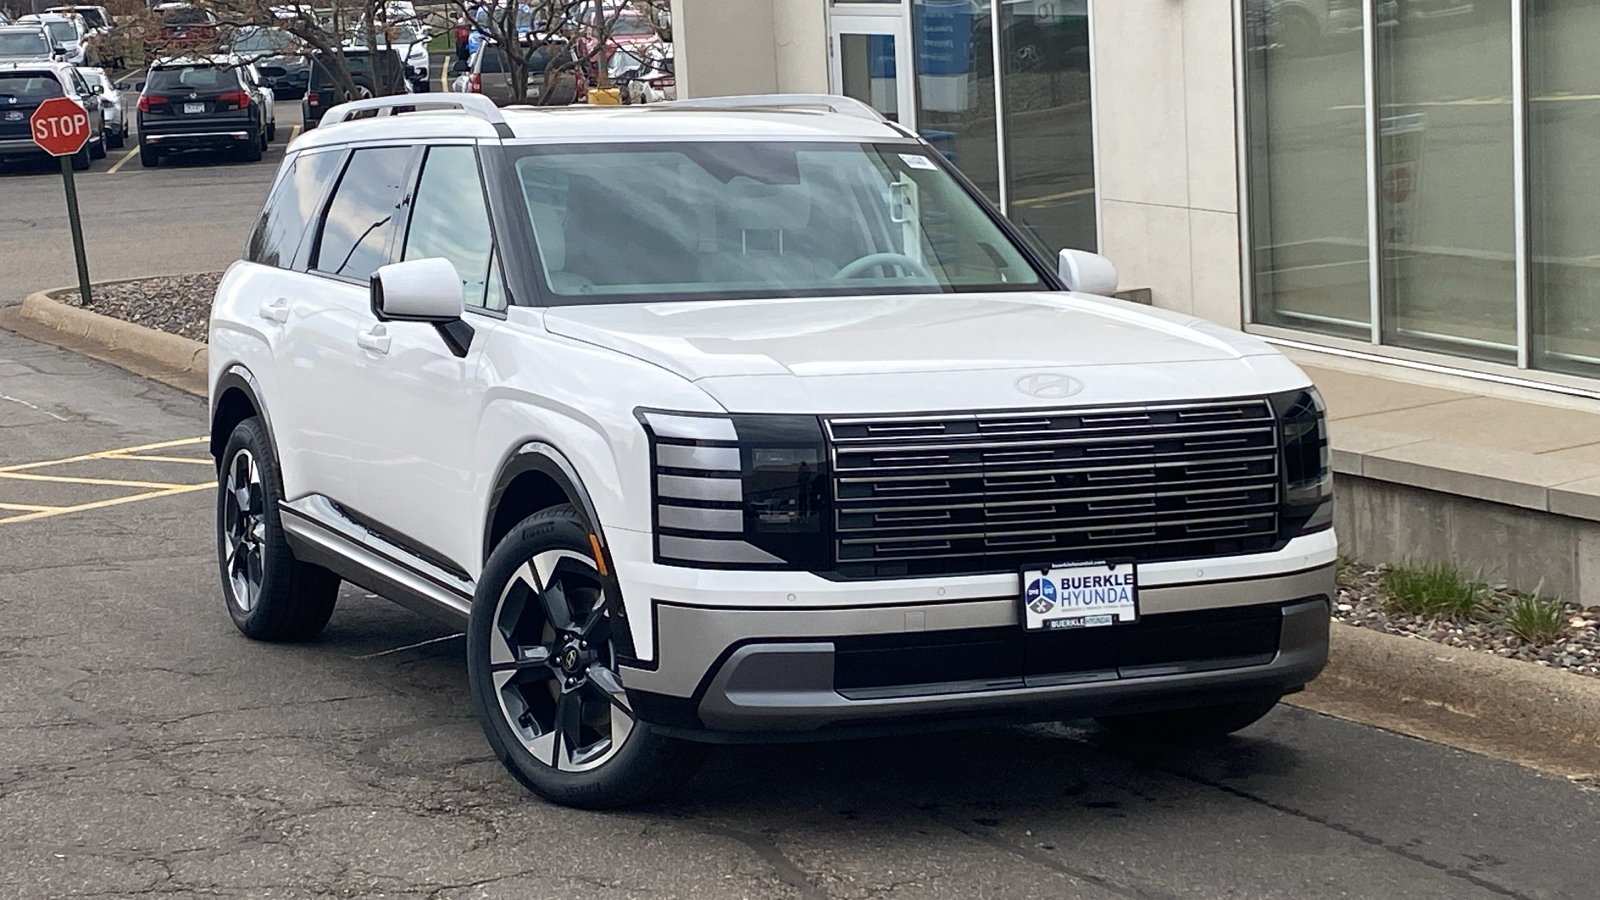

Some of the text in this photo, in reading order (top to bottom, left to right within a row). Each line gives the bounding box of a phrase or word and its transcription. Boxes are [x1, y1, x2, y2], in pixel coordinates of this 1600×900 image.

[35, 113, 86, 139] STOP
[1061, 573, 1134, 590] BUERKLE
[1051, 618, 1085, 628] BUERKLE
